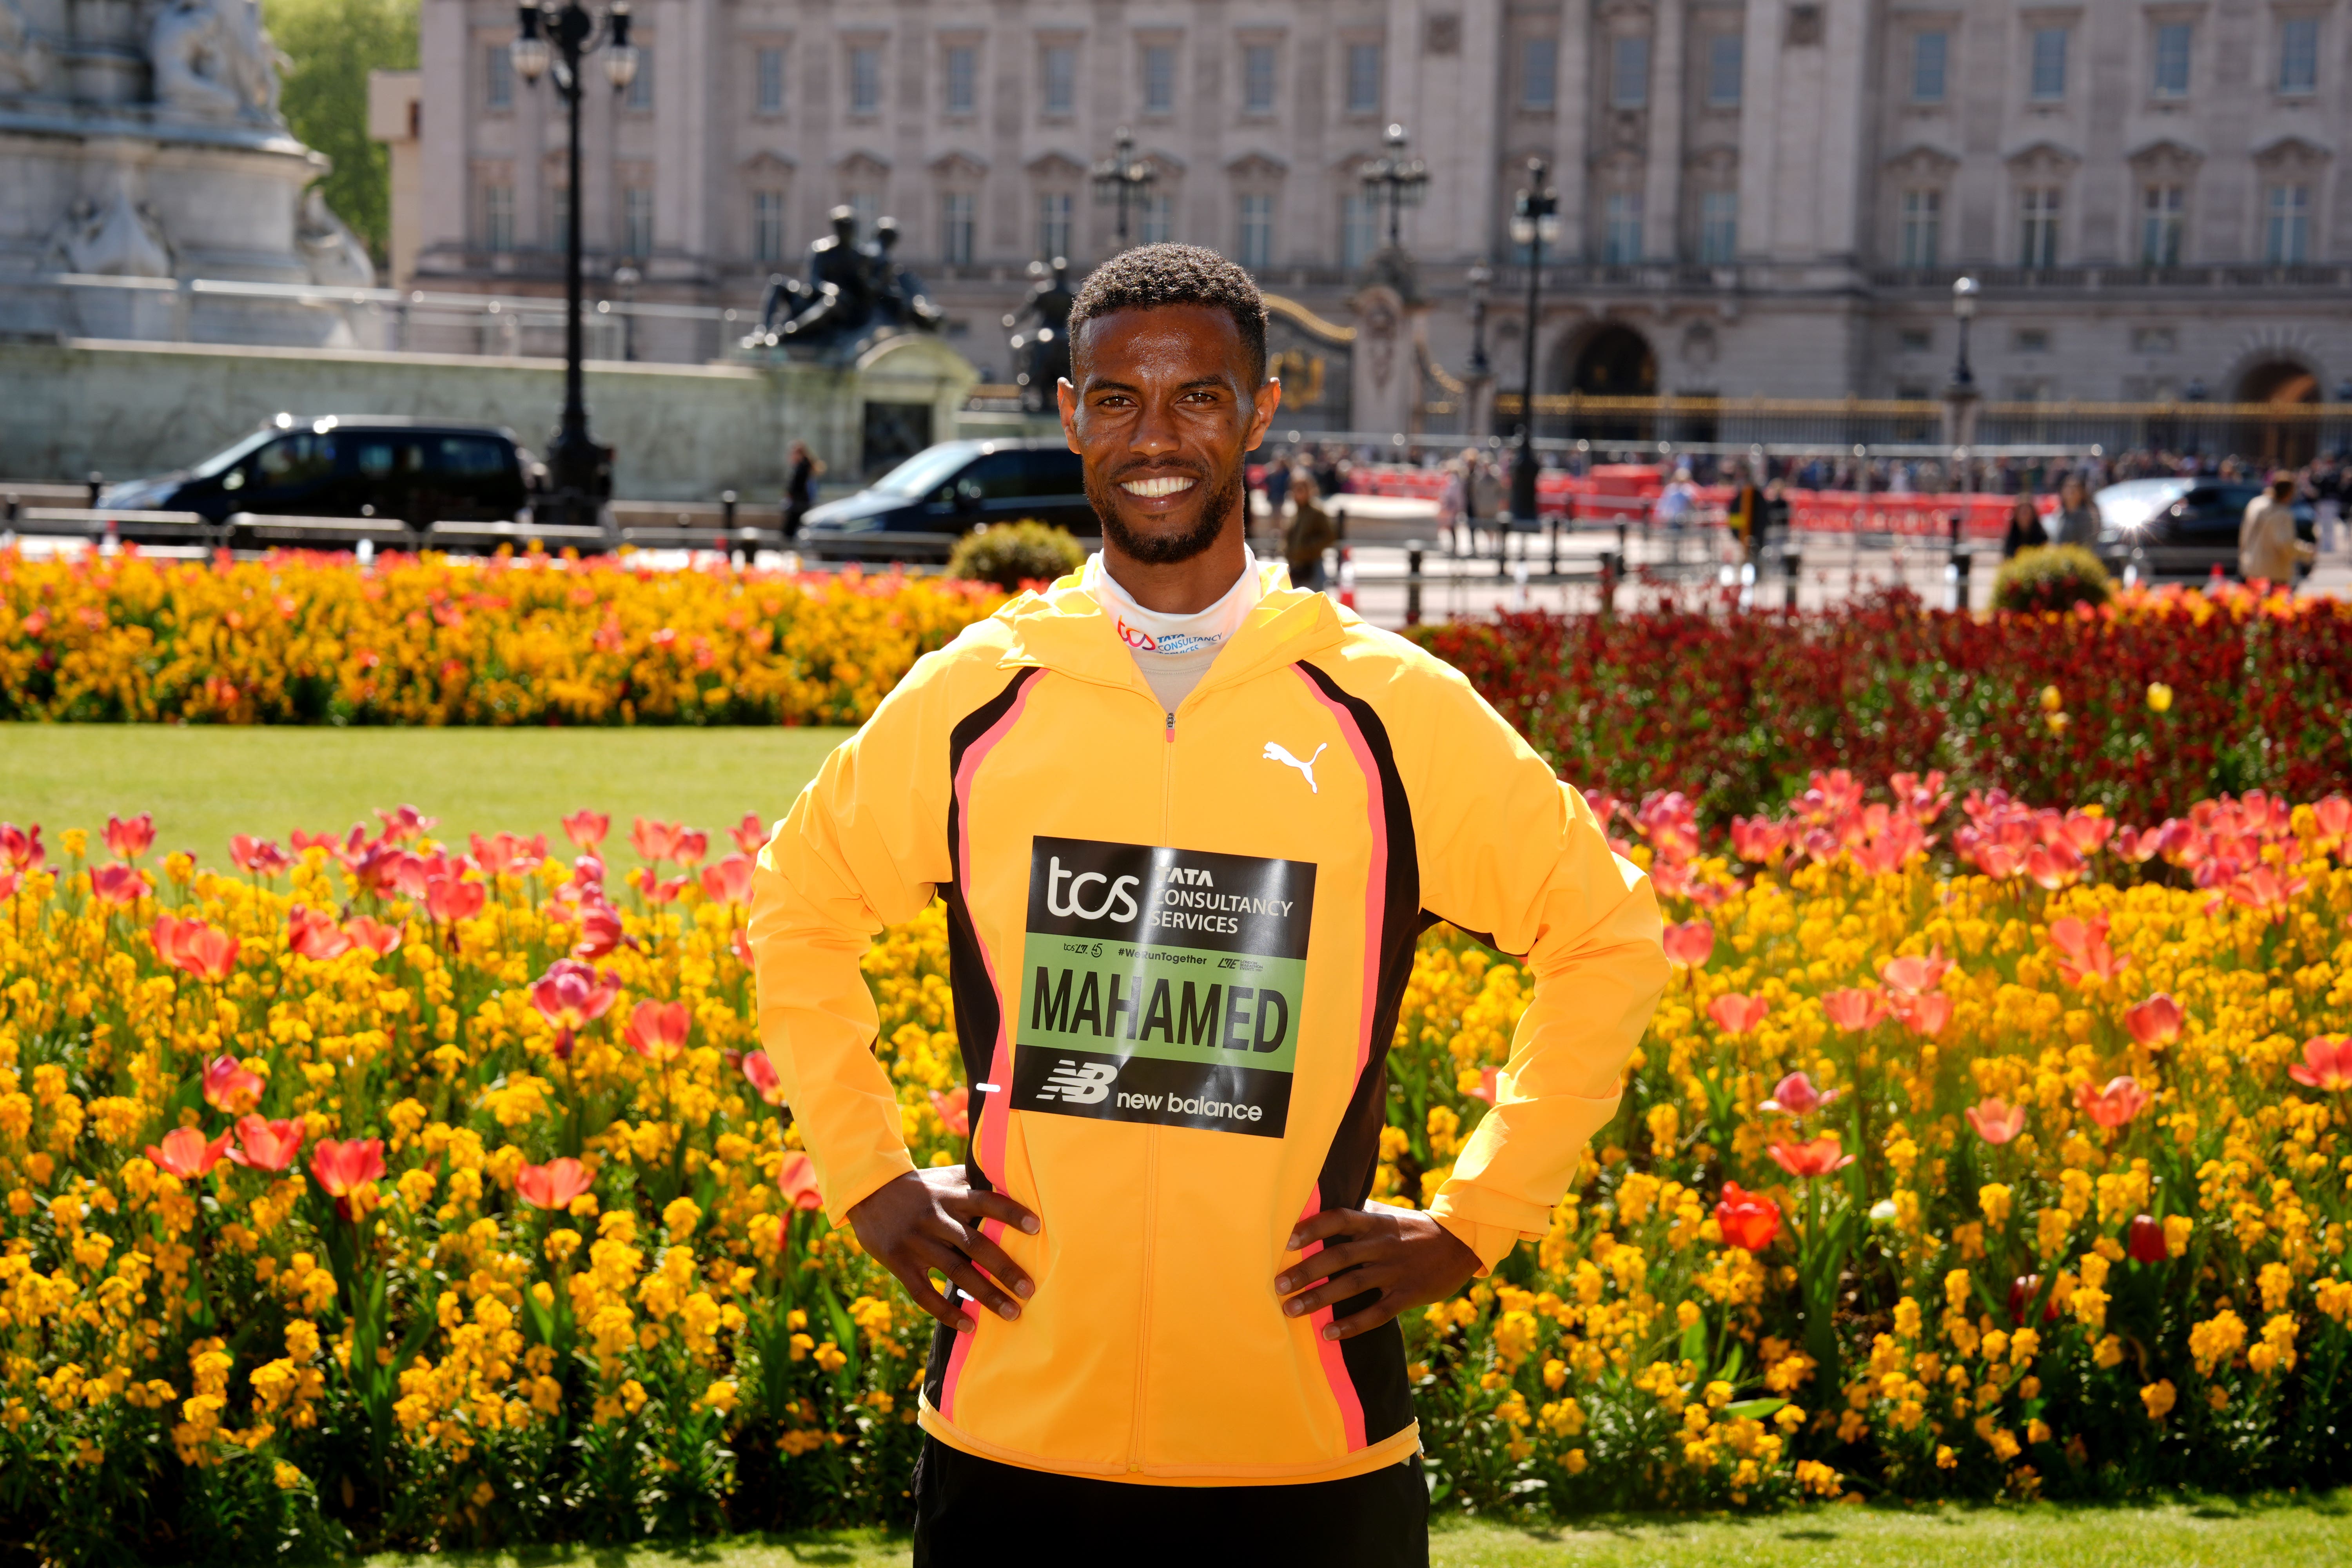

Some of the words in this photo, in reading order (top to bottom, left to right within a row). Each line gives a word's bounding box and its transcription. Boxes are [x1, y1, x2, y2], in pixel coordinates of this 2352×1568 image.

[1118, 614, 1156, 650] tcs
[1157, 634, 1185, 643] TATA
[1158, 632, 1222, 651] CONSULTANCY
[1155, 866, 1214, 887] TATA
[1047, 856, 1140, 923] tcs
[1152, 888, 1294, 917] CONSULTANCY
[1149, 910, 1239, 934] SERVICES
[1064, 943, 1075, 951] tcs
[1118, 948, 1207, 965] #WeRunTogether
[1031, 966, 1288, 1053] MAHAMED
[1117, 1092, 1163, 1111] new
[1167, 1092, 1263, 1122] balance
